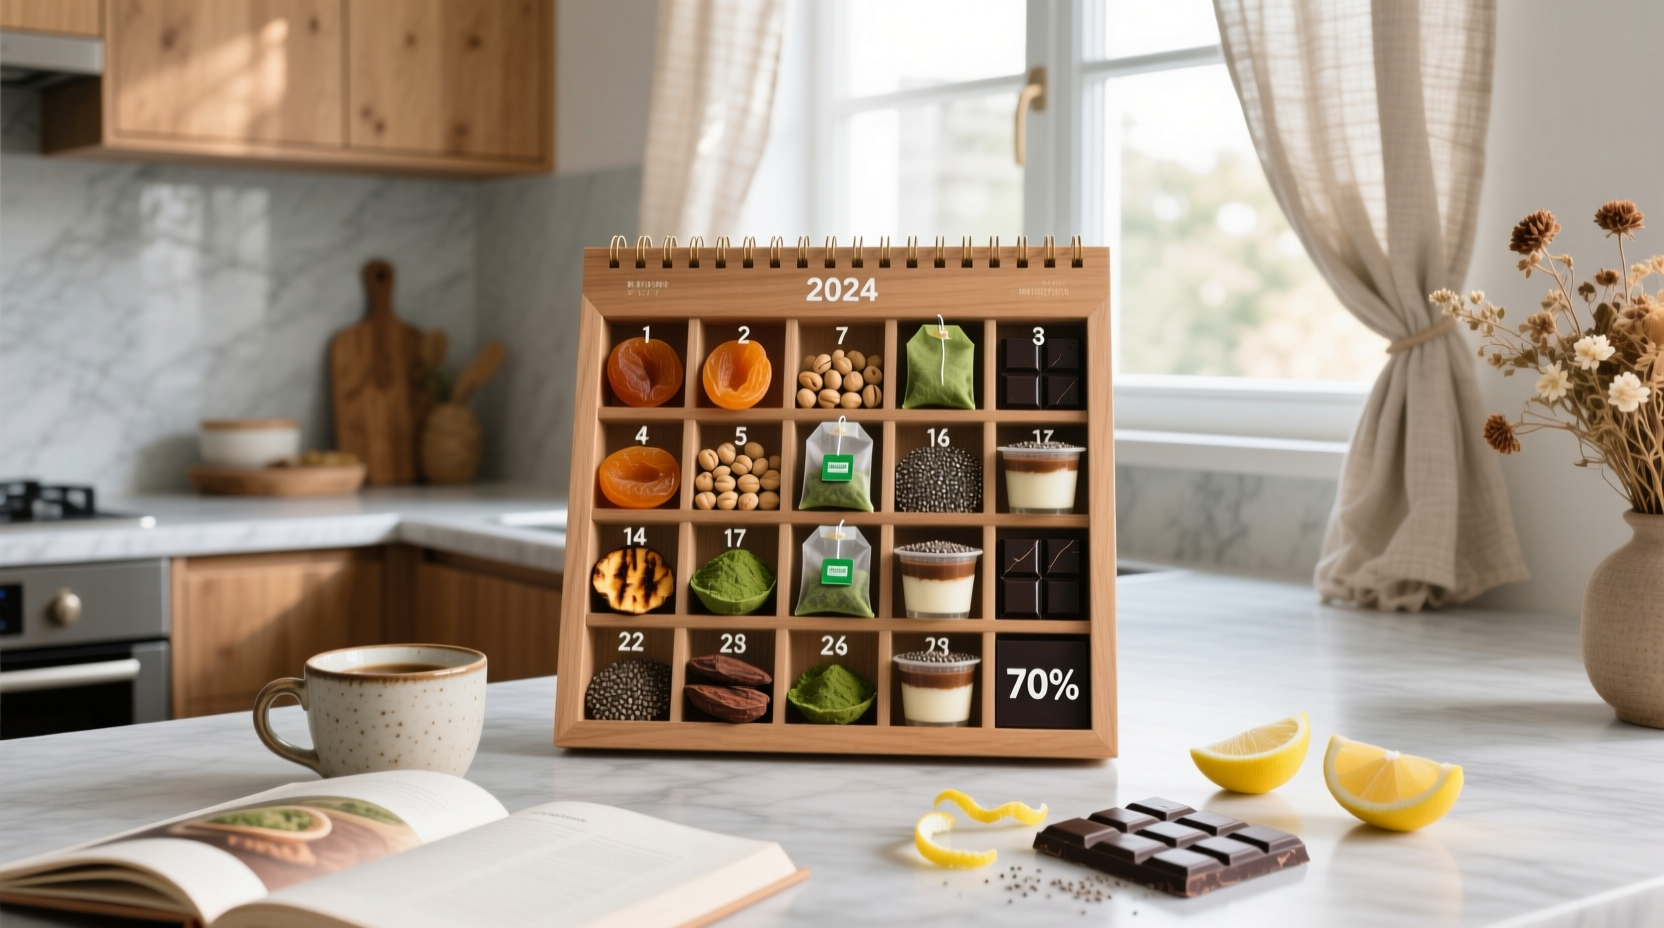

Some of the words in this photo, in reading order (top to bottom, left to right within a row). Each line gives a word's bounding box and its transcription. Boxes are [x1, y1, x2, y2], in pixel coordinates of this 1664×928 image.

[805, 276, 879, 302] 2024
[642, 325, 651, 344] 1
[737, 325, 750, 344] 2
[835, 326, 849, 345] 7
[1032, 326, 1045, 346] 3
[635, 425, 649, 445] 4
[734, 426, 747, 446] 5
[927, 428, 951, 448] 16
[623, 527, 647, 546] 14
[724, 528, 747, 548] 17
[618, 632, 644, 652] 22
[820, 635, 848, 656] 26
[1006, 667, 1080, 702] 70%
